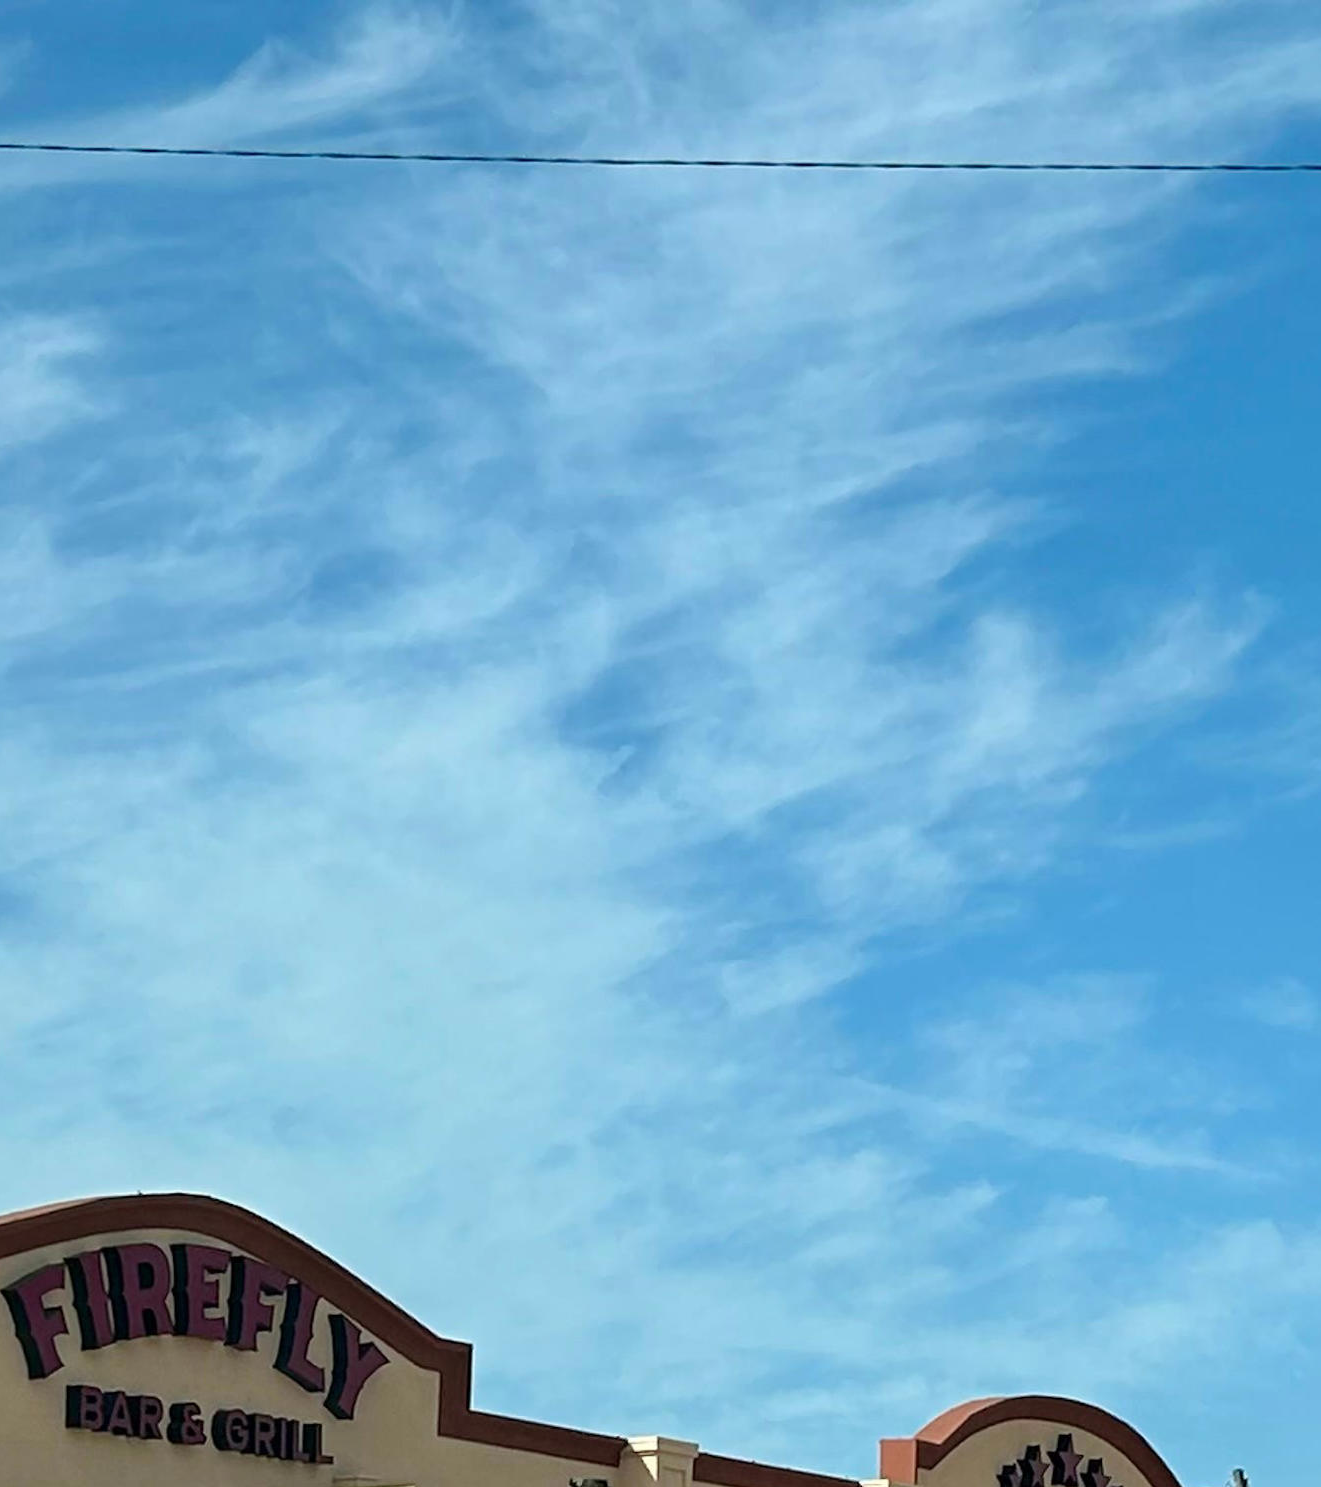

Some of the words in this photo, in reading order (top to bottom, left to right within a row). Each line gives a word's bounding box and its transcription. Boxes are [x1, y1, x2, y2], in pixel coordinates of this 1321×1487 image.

[0, 1242, 389, 1420] FIREFLY
[65, 1384, 163, 1440] BAR
[167, 1401, 207, 1445] &
[212, 1408, 335, 1464] GRILL
